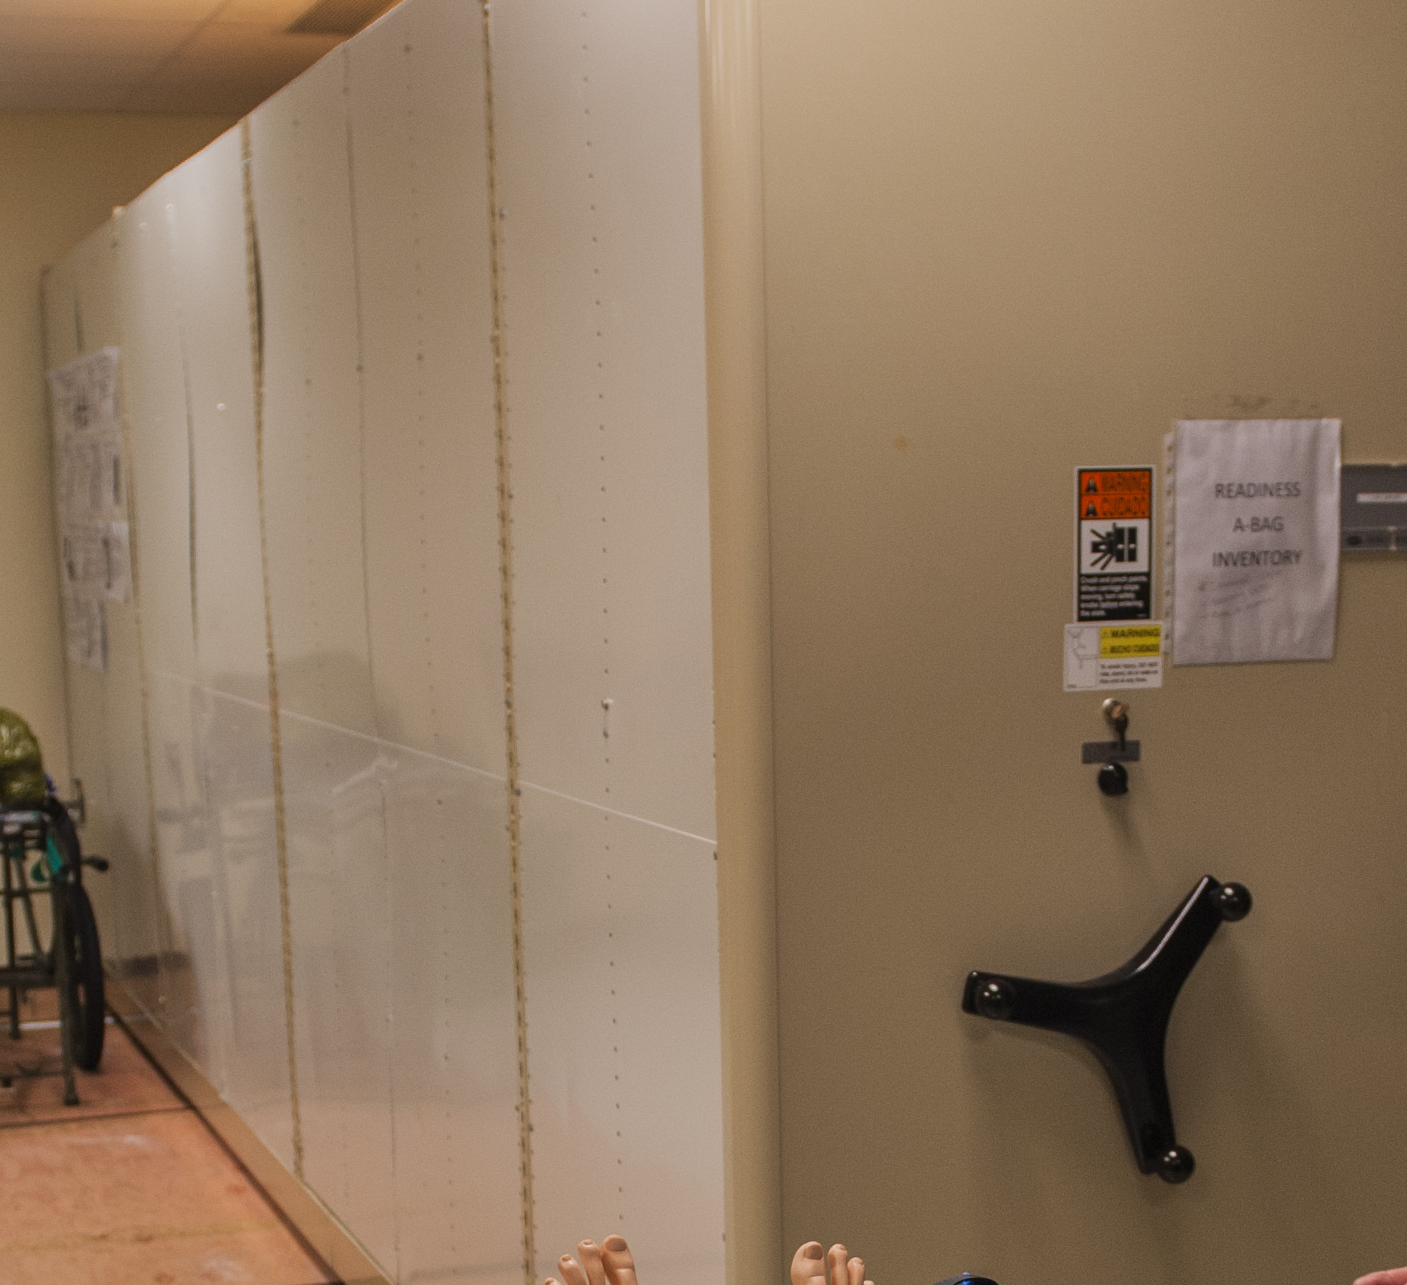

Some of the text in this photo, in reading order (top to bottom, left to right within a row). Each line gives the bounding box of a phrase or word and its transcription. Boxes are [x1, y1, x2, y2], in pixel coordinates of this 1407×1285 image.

[1214, 481, 1302, 499] READINESS
[1232, 516, 1285, 533] A-BAG
[1212, 550, 1302, 568] INVENTORY
